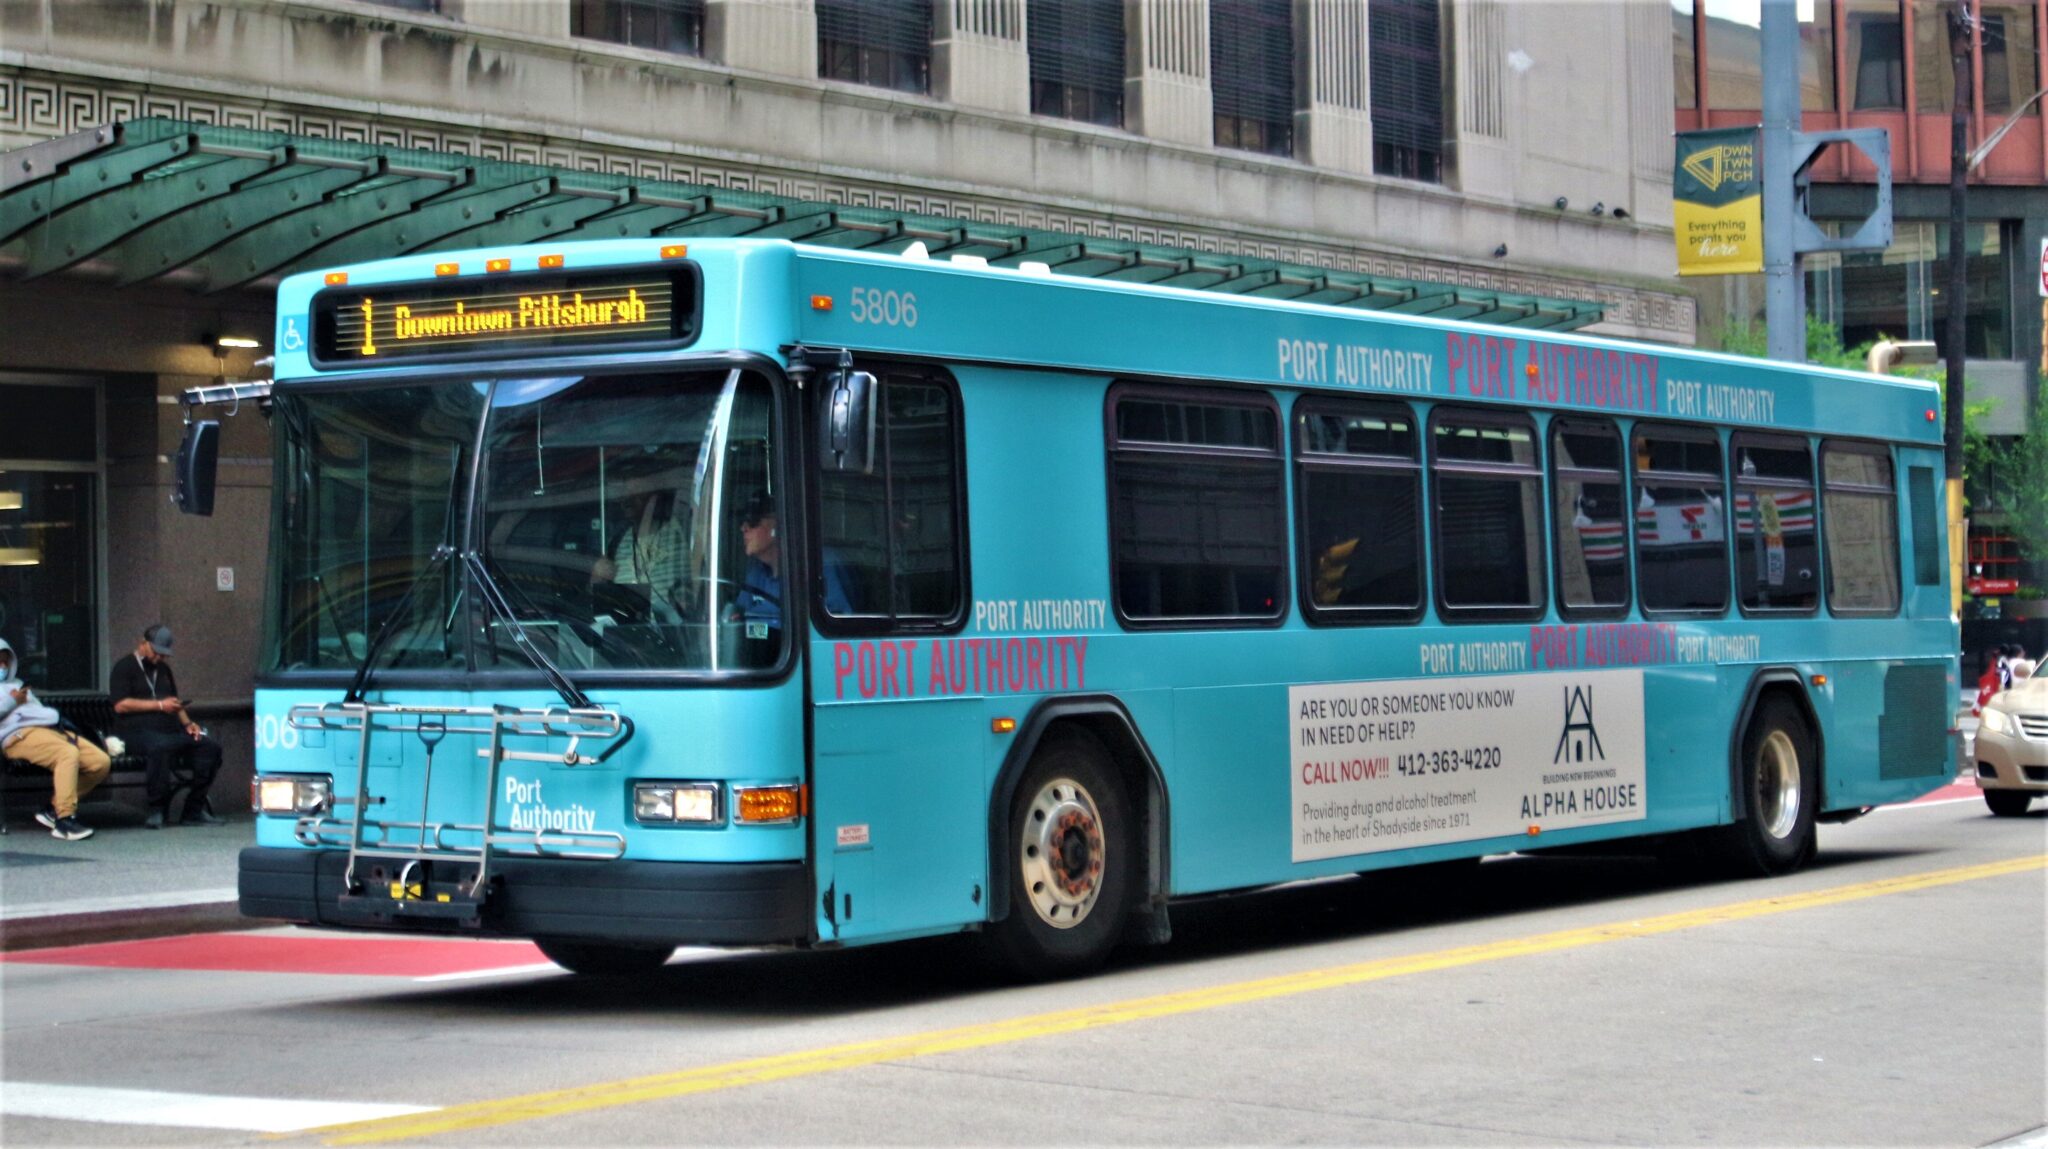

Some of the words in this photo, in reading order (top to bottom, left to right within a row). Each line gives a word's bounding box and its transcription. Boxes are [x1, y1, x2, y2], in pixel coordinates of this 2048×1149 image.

[1723, 145, 1752, 158] DWN
[1723, 158, 1752, 170] TWN
[1723, 171, 1752, 182] PGH
[1689, 220, 1746, 232] Everything
[1690, 233, 1722, 246] points
[1727, 234, 1746, 244] you
[1700, 239, 1738, 257] here
[361, 298, 376, 355] 1
[396, 302, 512, 339] Downtown
[519, 289, 645, 327] Pittsburgh
[850, 286, 918, 328] 5806
[1278, 338, 1328, 382] PORT
[1335, 344, 1433, 391] AUTHORITY
[1446, 332, 1516, 397] PORT
[1527, 341, 1659, 412] AUTHORITY
[1666, 379, 1701, 415] PORT
[1705, 383, 1776, 423] AUTHORITY
[976, 600, 1017, 631] PORT
[1023, 600, 1107, 630] AUTHORITY
[1420, 643, 1455, 674] PORT
[1459, 641, 1526, 671] AUTHORITY
[1530, 625, 1578, 669] PORT
[1584, 624, 1677, 667] AUTHORITY
[1678, 636, 1704, 662] PORT
[1708, 635, 1761, 661] AUTHORITY
[834, 640, 917, 699] PORT
[929, 636, 1088, 695] AUTHORITY
[1300, 700, 1326, 720] ARE
[1329, 698, 1357, 718] YOU
[1361, 697, 1379, 717] OR
[1383, 693, 1446, 716] SOMEONE
[1449, 692, 1474, 711] YOU
[1477, 689, 1515, 709] KNOW
[1301, 727, 1316, 747] IN
[1320, 725, 1354, 745] NEED
[1358, 723, 1375, 743] OF
[1378, 720, 1415, 742] HELP?
[1302, 760, 1337, 785] CALL
[1341, 757, 1389, 781] NOW!!!
[1398, 747, 1501, 776] 412-363-4220
[1543, 773, 1569, 784] BUILDING
[1570, 771, 1582, 782] NEW
[1583, 769, 1616, 780] BEGINNINGS
[506, 777, 541, 803] Port
[1303, 802, 1349, 821] Providing
[1351, 799, 1373, 818] drug
[1375, 795, 1393, 813] and
[1395, 792, 1429, 811] alcohol
[1430, 789, 1477, 808] treatment
[1521, 790, 1577, 819] ALPHA
[1584, 784, 1637, 811] HOUSE
[510, 803, 595, 832] Authority
[1303, 829, 1312, 845] in
[1314, 827, 1331, 844] the
[1333, 824, 1359, 841] heart
[1361, 821, 1371, 838] of
[1372, 816, 1421, 837] Shadyside
[1423, 816, 1447, 831] since
[1448, 813, 1470, 828] 1971
